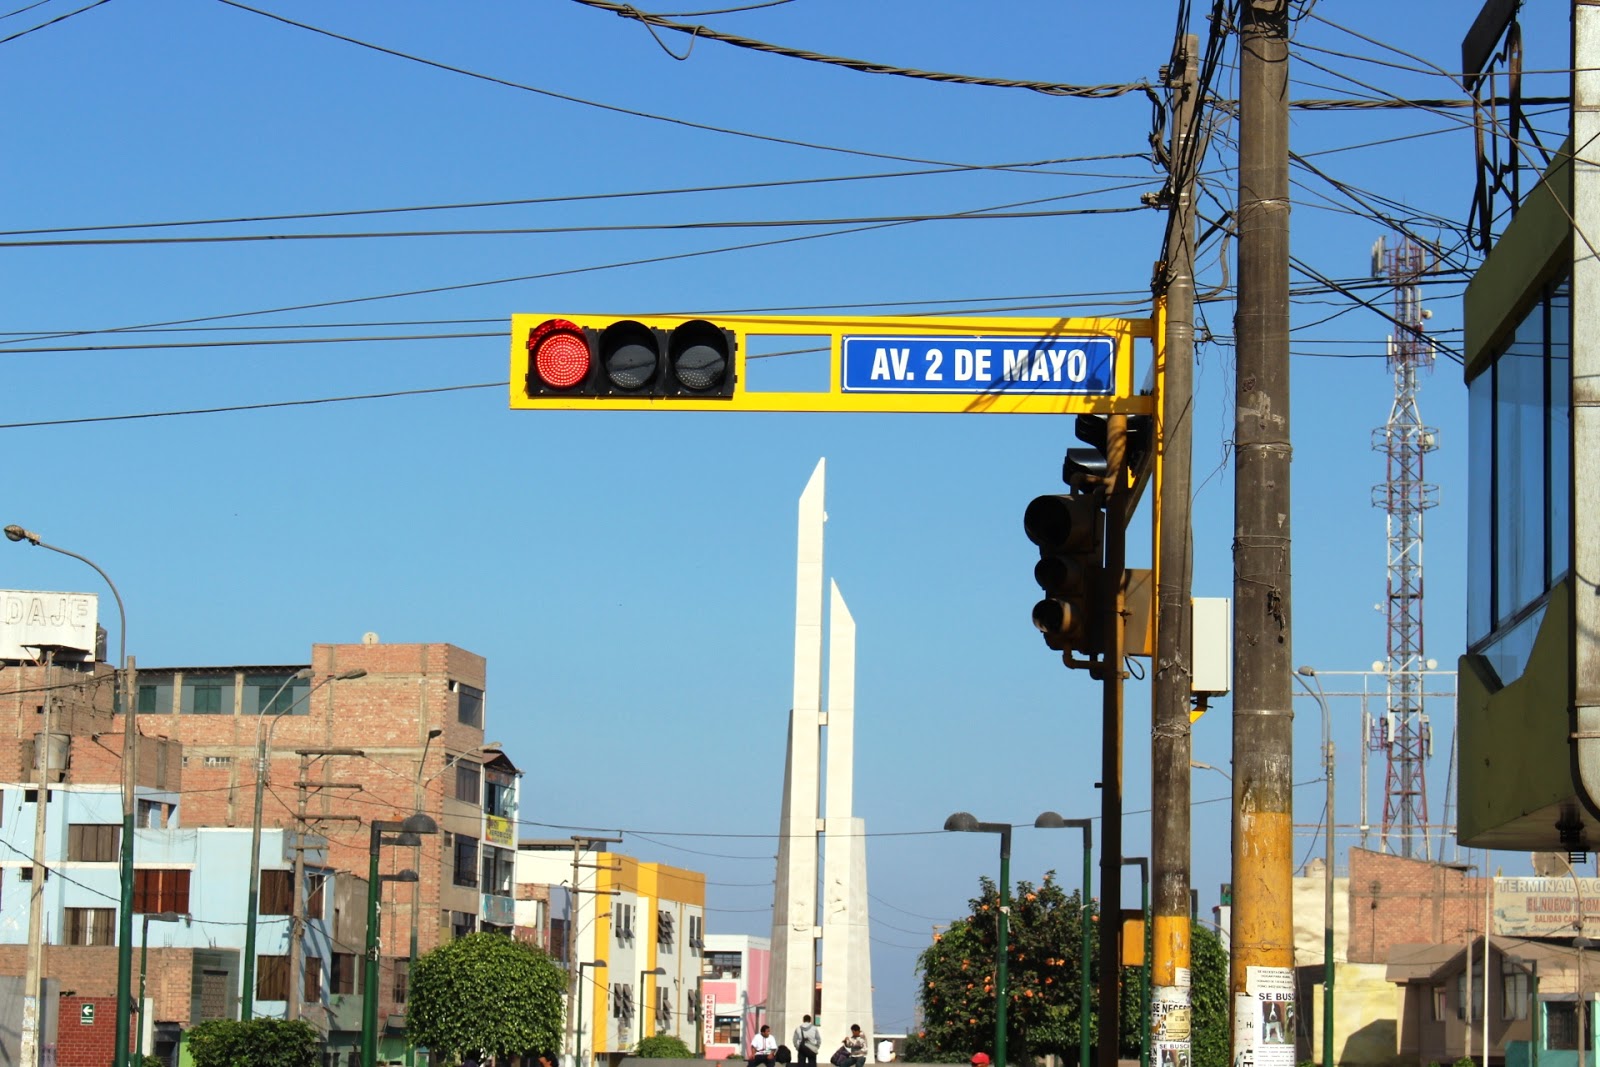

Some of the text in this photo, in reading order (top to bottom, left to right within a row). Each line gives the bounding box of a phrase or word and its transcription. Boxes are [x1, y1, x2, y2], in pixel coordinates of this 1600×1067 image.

[870, 347, 1087, 382] AV. 2 DE MAYO
[0, 596, 88, 628] DAJE
[1500, 879, 1575, 893] TERMINAL
[1526, 896, 1539, 913] EL
[1540, 896, 1572, 913] NUEVO
[1535, 915, 1562, 923] SALIDAS
[1563, 915, 1577, 923] CAD
[1258, 992, 1272, 1000] SE
